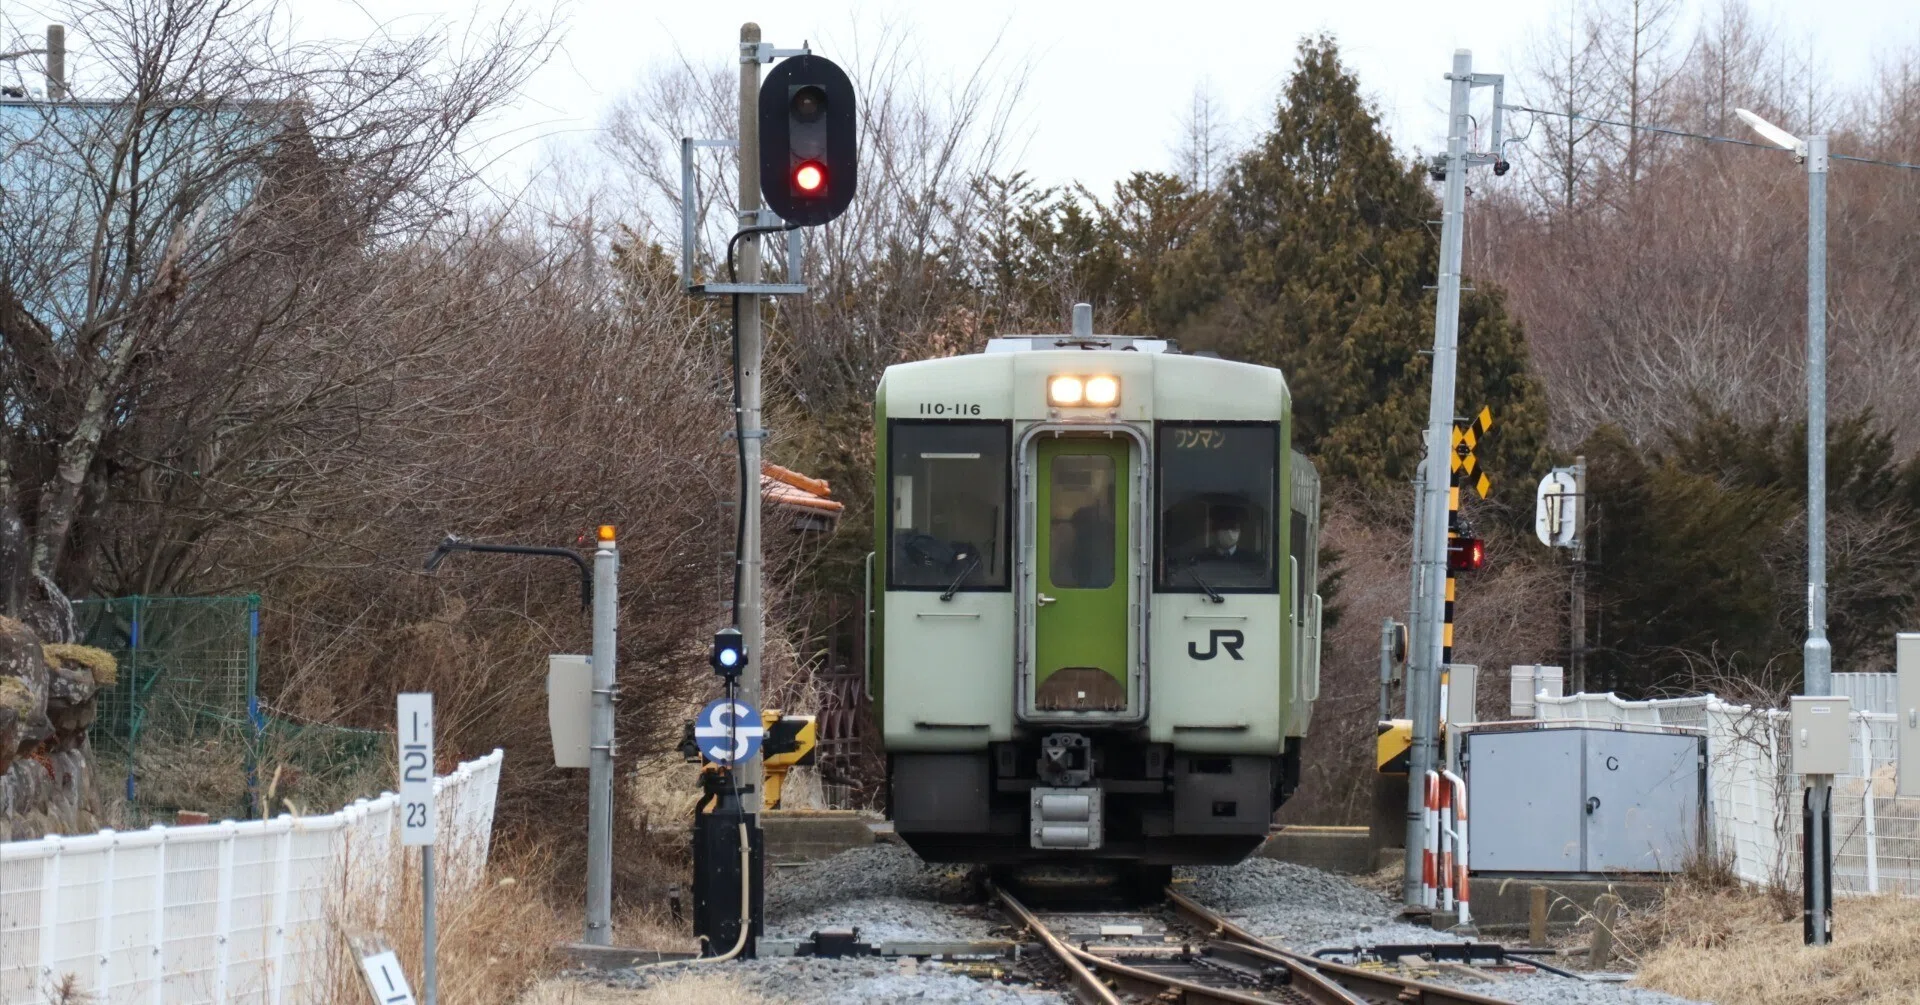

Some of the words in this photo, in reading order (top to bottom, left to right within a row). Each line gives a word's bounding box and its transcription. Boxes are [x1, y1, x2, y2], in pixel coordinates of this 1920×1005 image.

[920, 403, 981, 415] 110-116
[1175, 429, 1225, 448] ワンマン
[1188, 629, 1244, 660] JR
[1606, 756, 1619, 771] C
[407, 803, 427, 828] 23
